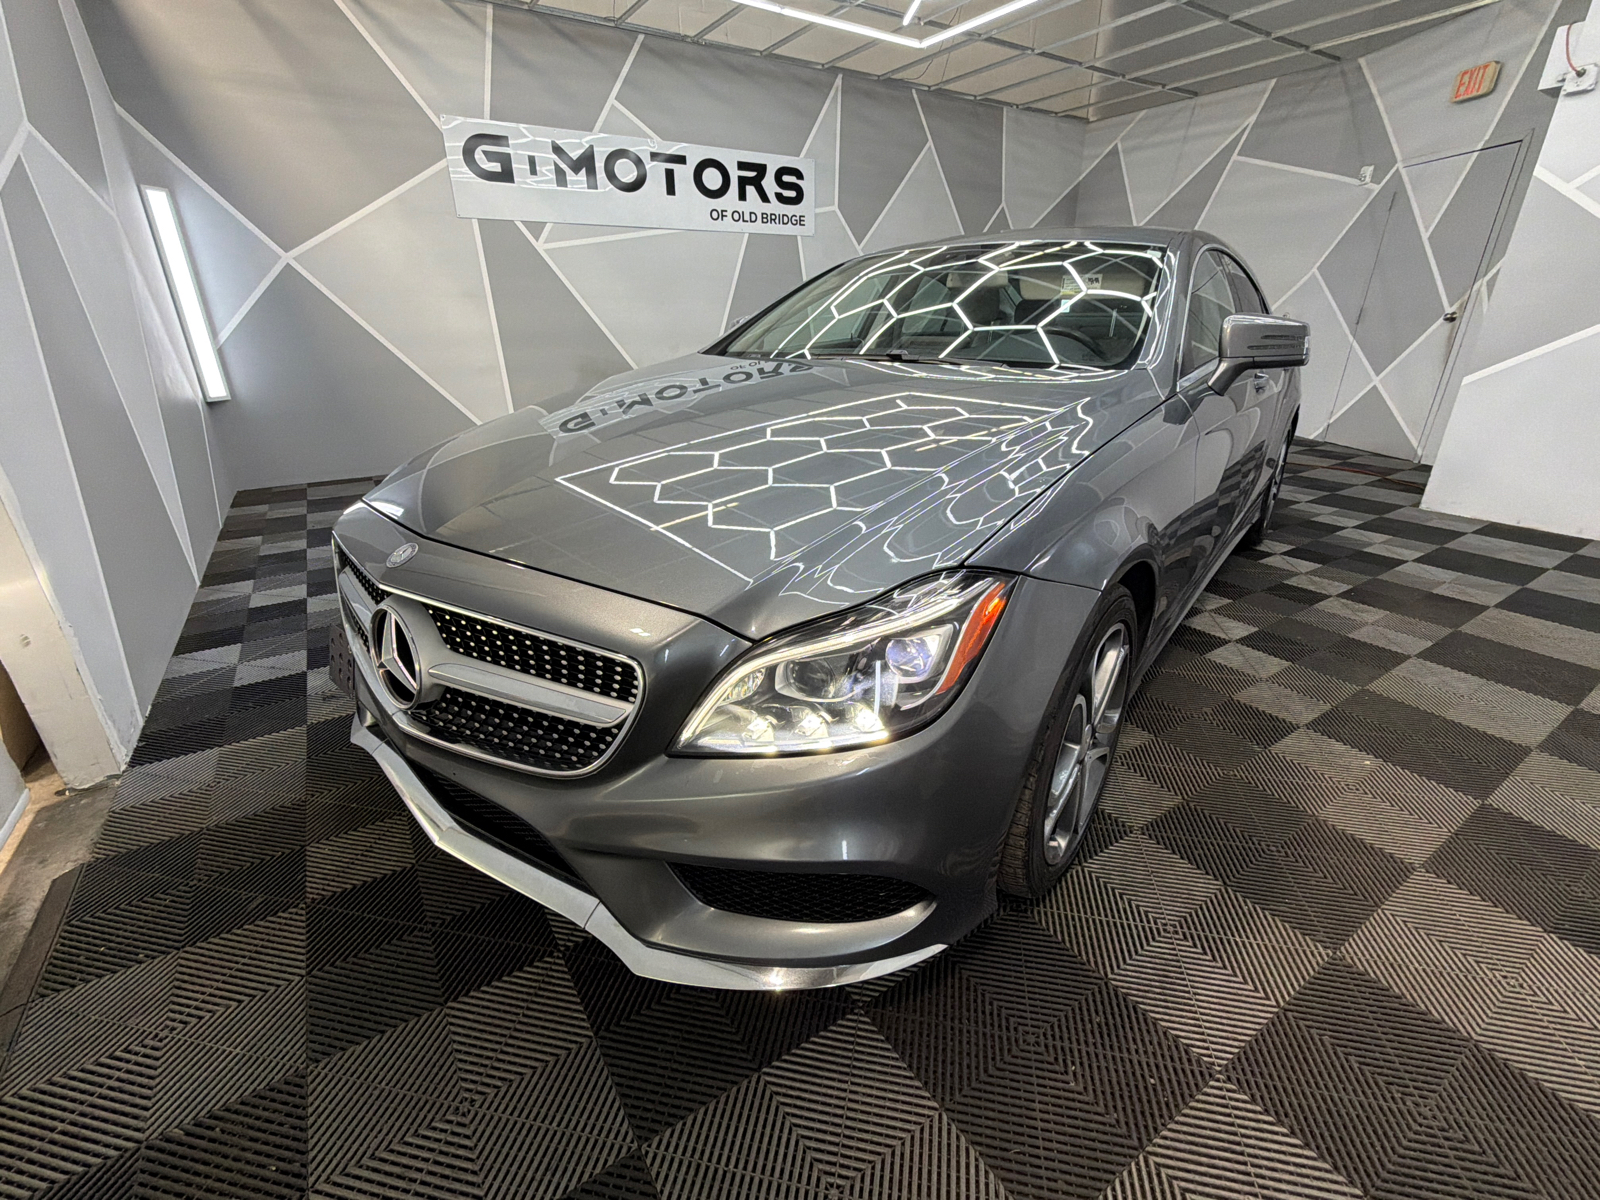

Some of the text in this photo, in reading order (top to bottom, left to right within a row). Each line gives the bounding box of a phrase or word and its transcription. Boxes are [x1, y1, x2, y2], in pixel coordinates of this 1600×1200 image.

[1454, 63, 1491, 99] EXIT
[709, 208, 806, 227] OF OLD BRIDGE
